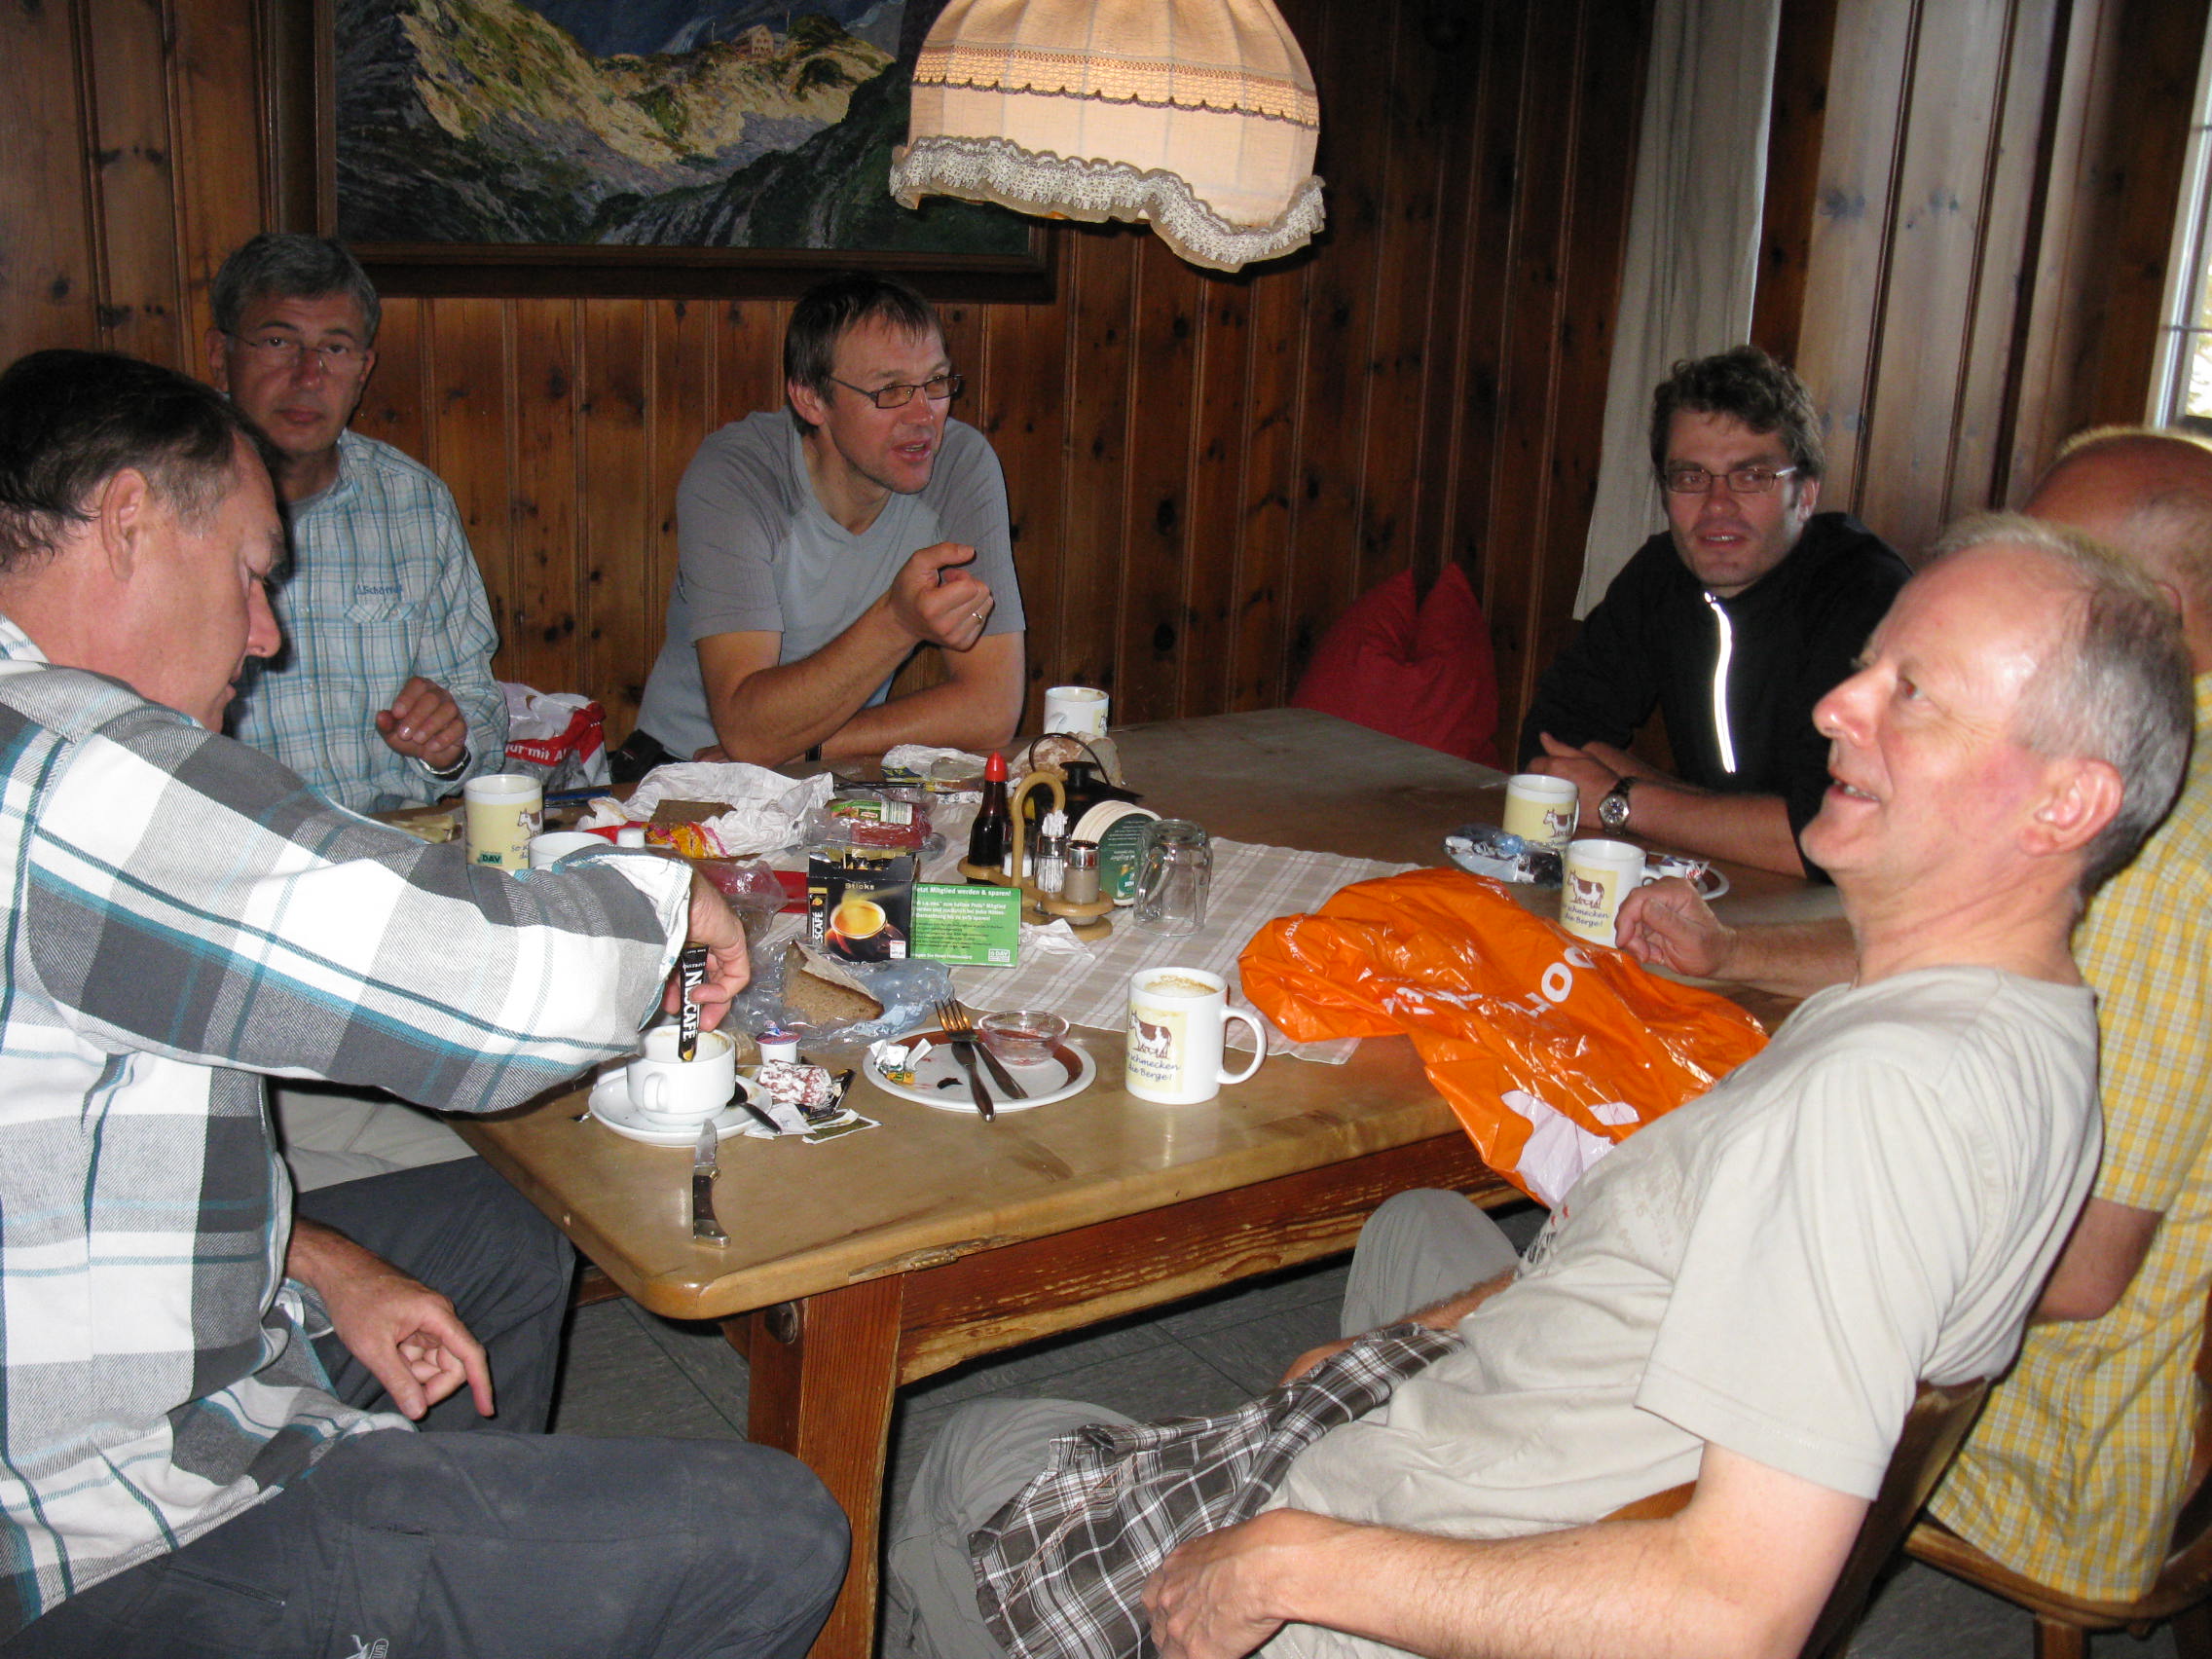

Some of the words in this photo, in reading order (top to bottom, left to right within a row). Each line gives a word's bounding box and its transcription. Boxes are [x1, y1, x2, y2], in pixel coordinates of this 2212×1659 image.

[528, 747, 550, 759] mit
[481, 854, 501, 864] DAV
[929, 886, 956, 895] Mitglied
[812, 911, 824, 943] SCAFÉ
[1130, 1053, 1181, 1070] schmecken
[1139, 1068, 1172, 1083] Berge!
